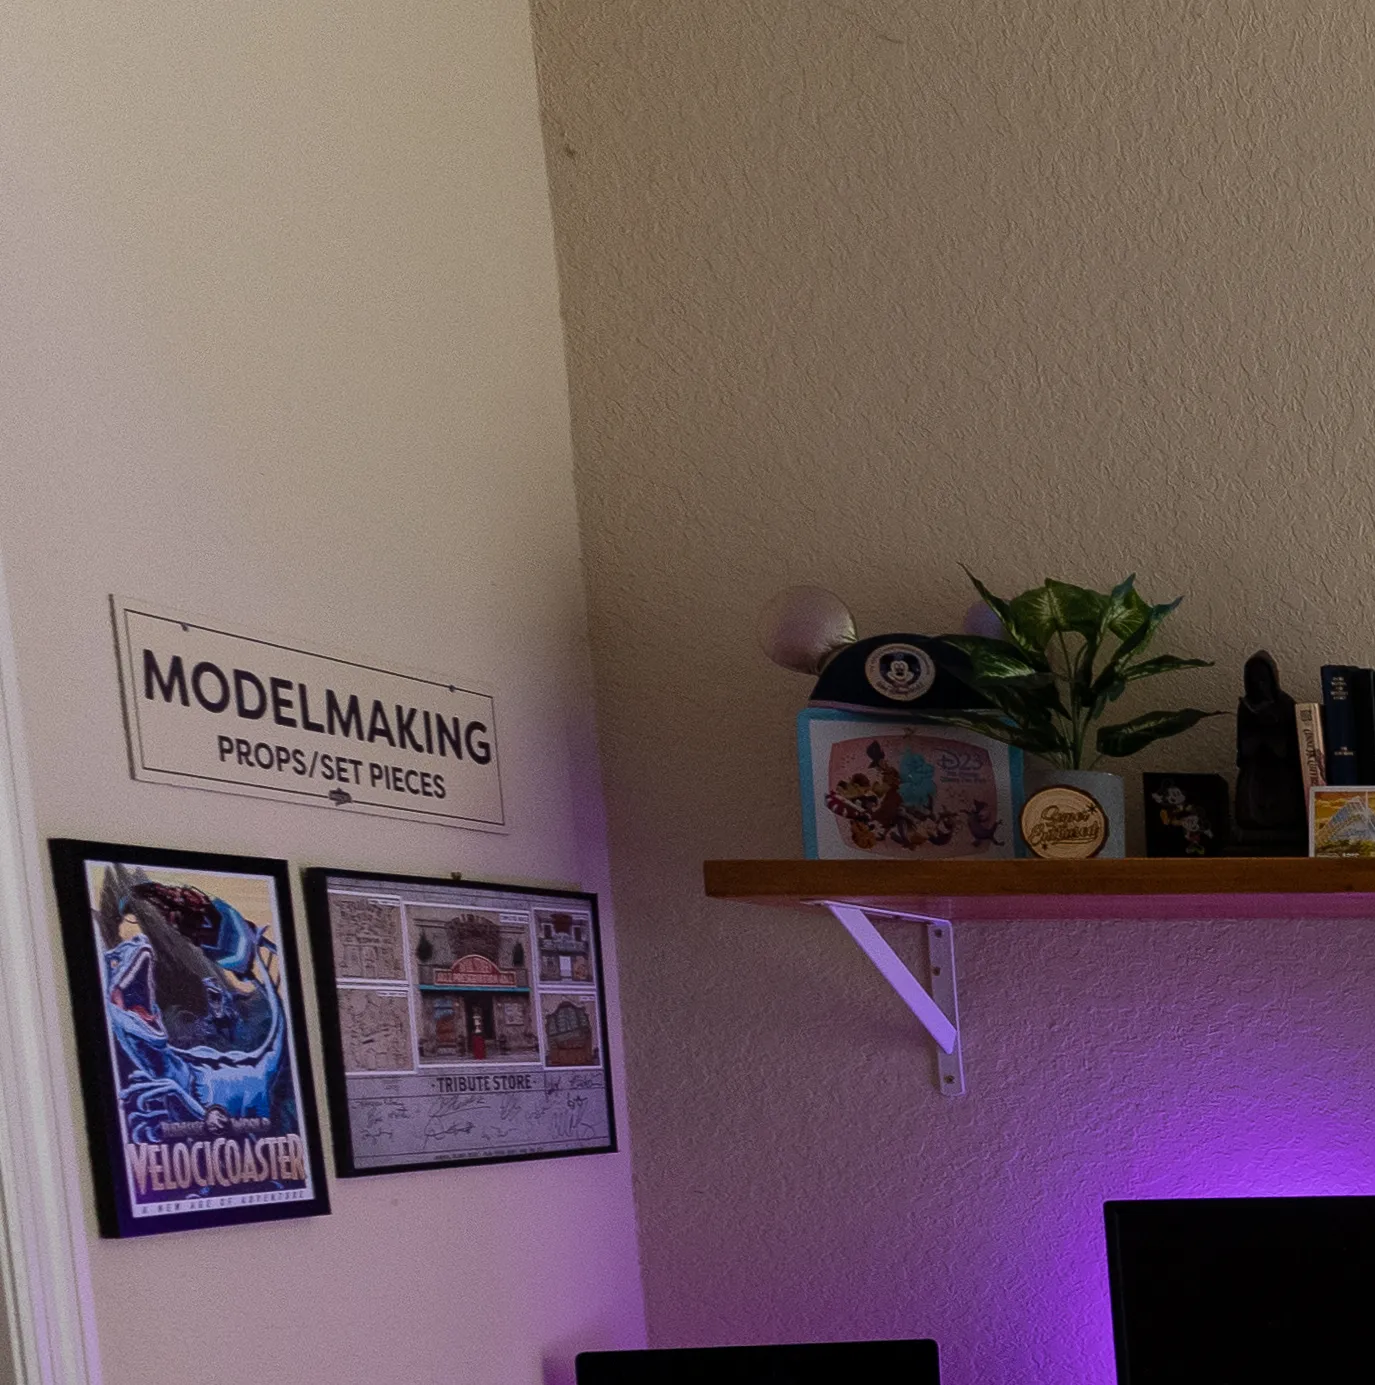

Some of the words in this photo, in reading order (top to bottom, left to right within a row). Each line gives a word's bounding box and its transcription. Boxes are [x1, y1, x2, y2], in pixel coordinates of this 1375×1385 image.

[143, 648, 492, 765] MODELMAKING
[217, 734, 363, 787] PROPS/SET
[369, 762, 447, 799] PIECES
[436, 1075, 491, 1093] TRIBUTE
[493, 1074, 532, 1091] STORE
[125, 1132, 306, 1196] VELOCICOASTER
